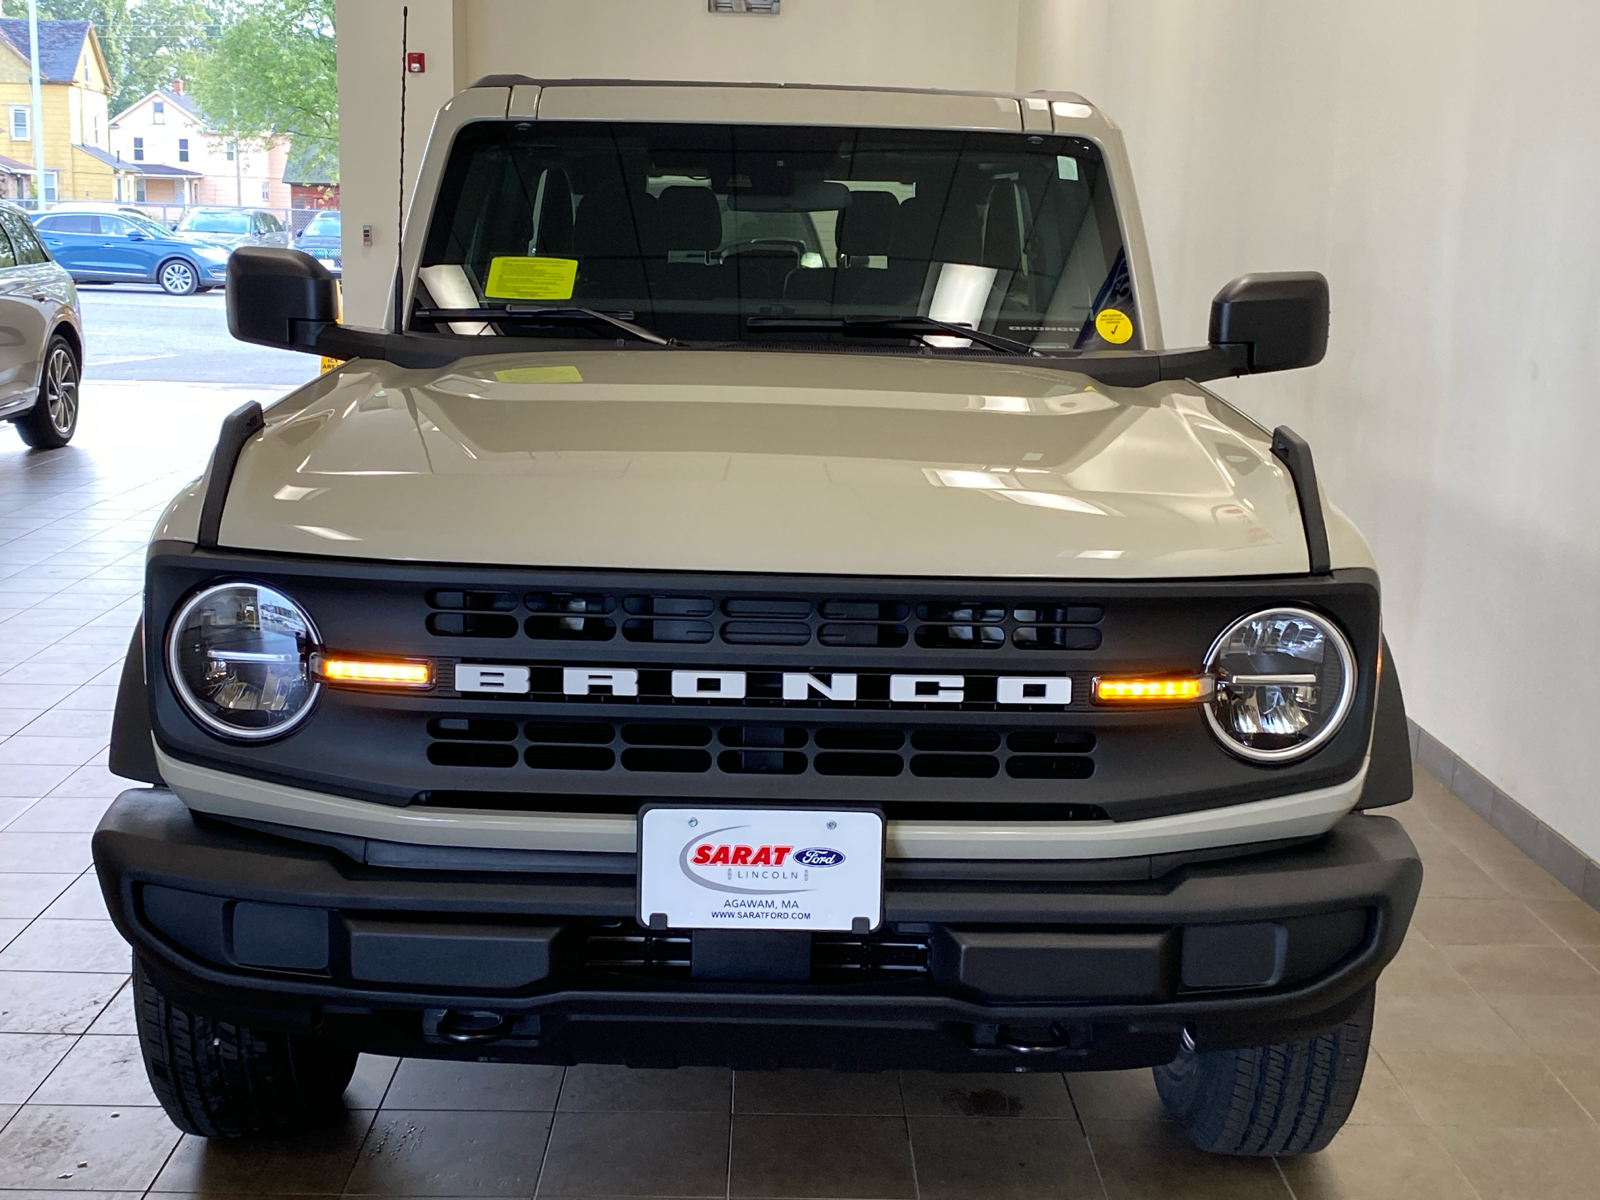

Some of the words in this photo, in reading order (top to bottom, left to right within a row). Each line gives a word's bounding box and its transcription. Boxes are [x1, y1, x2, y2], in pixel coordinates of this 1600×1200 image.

[454, 663, 1073, 705] BRONCO
[692, 844, 793, 866] SARAT
[801, 848, 838, 865] Ford
[737, 870, 799, 880] LINCOLN
[723, 899, 778, 909] AGAWAM,
[781, 900, 799, 909] MA
[711, 911, 811, 920] WWW.SARATFORD.COM
